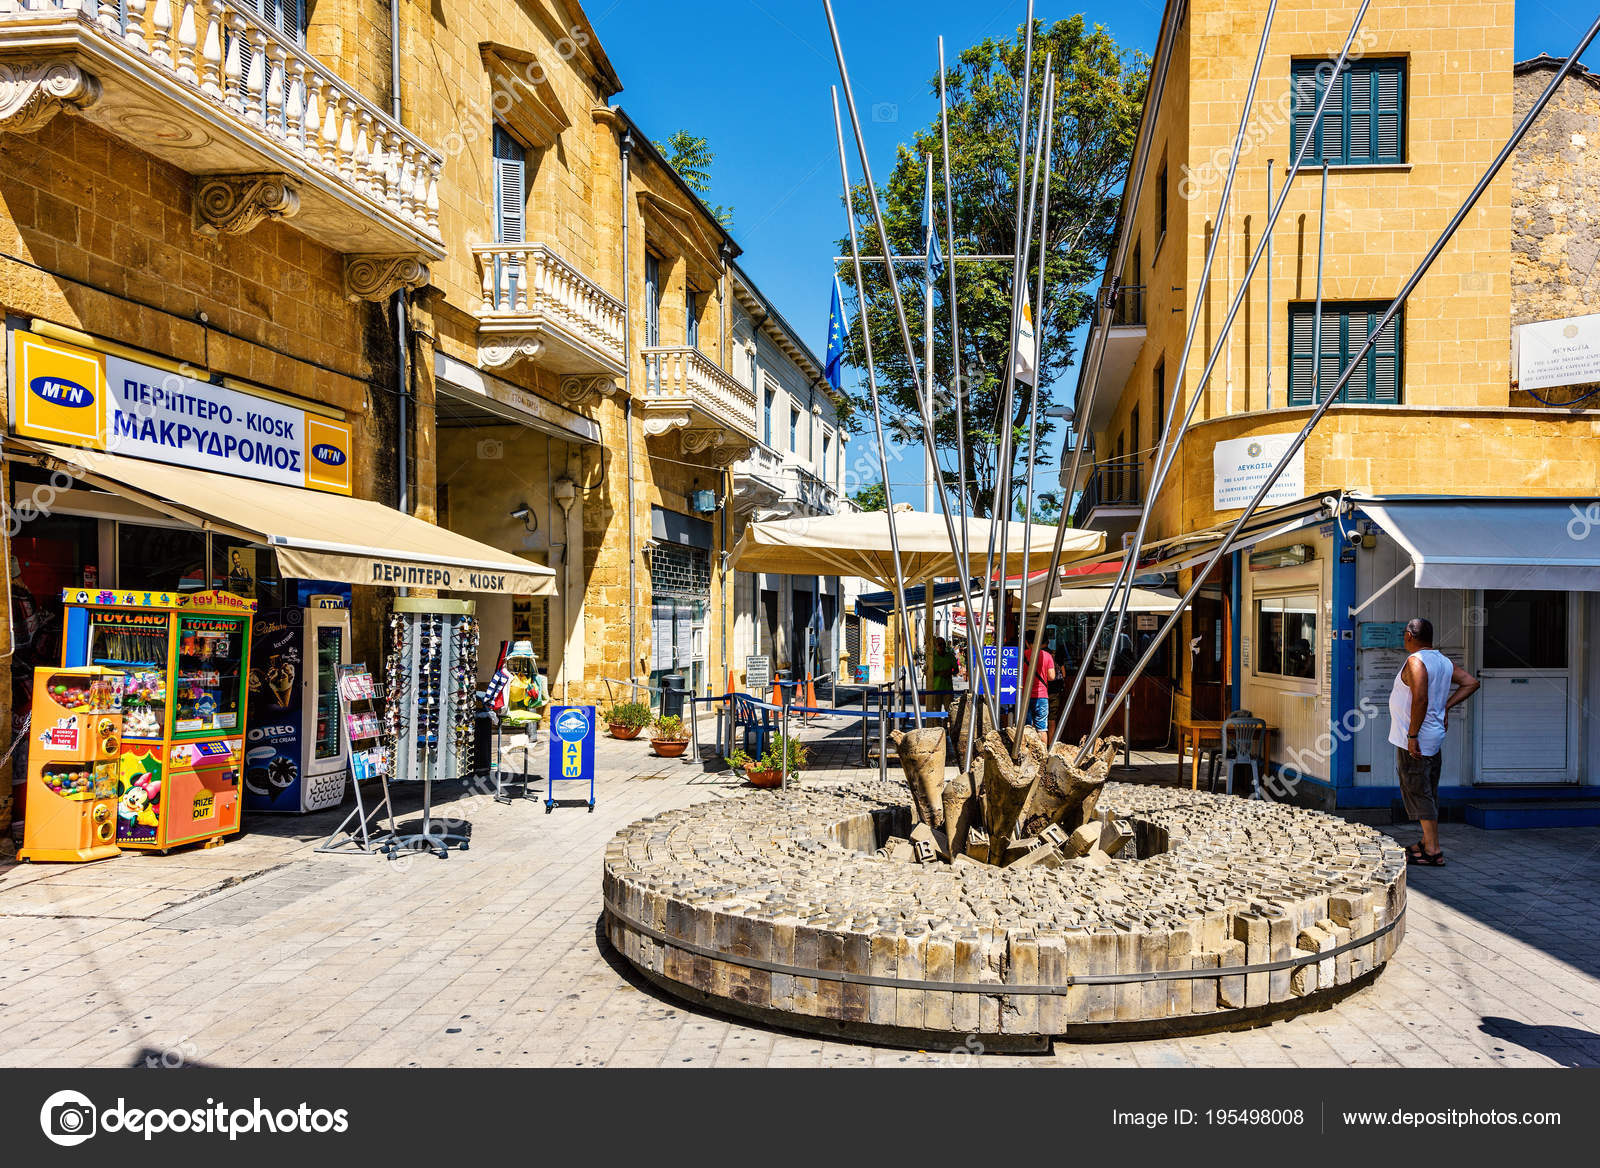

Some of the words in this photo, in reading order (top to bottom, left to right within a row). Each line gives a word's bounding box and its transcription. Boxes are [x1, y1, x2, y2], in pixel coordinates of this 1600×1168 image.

[41, 381, 84, 404] MTN
[124, 379, 233, 424] ΠΕΡΙΠΤΕΡΟ
[246, 413, 295, 441] KIOSK
[113, 409, 301, 473] ΜΑΚΡΥΔΡΟΜΟΣ
[317, 446, 342, 464] MTN
[1237, 462, 1273, 471] ΛΕΥΚΩΣΙΑ
[373, 563, 451, 586] ΠΕΡΙΠΤΕΡΟ
[469, 574, 504, 590] KIOSK
[193, 595, 212, 606] toy
[217, 595, 244, 607] shop
[320, 599, 344, 609] ATM
[95, 612, 165, 624] TOYLAND
[185, 620, 237, 631] TOYLAND
[248, 725, 295, 741] OREO
[566, 743, 579, 777] ATM
[193, 808, 209, 818] OUT
